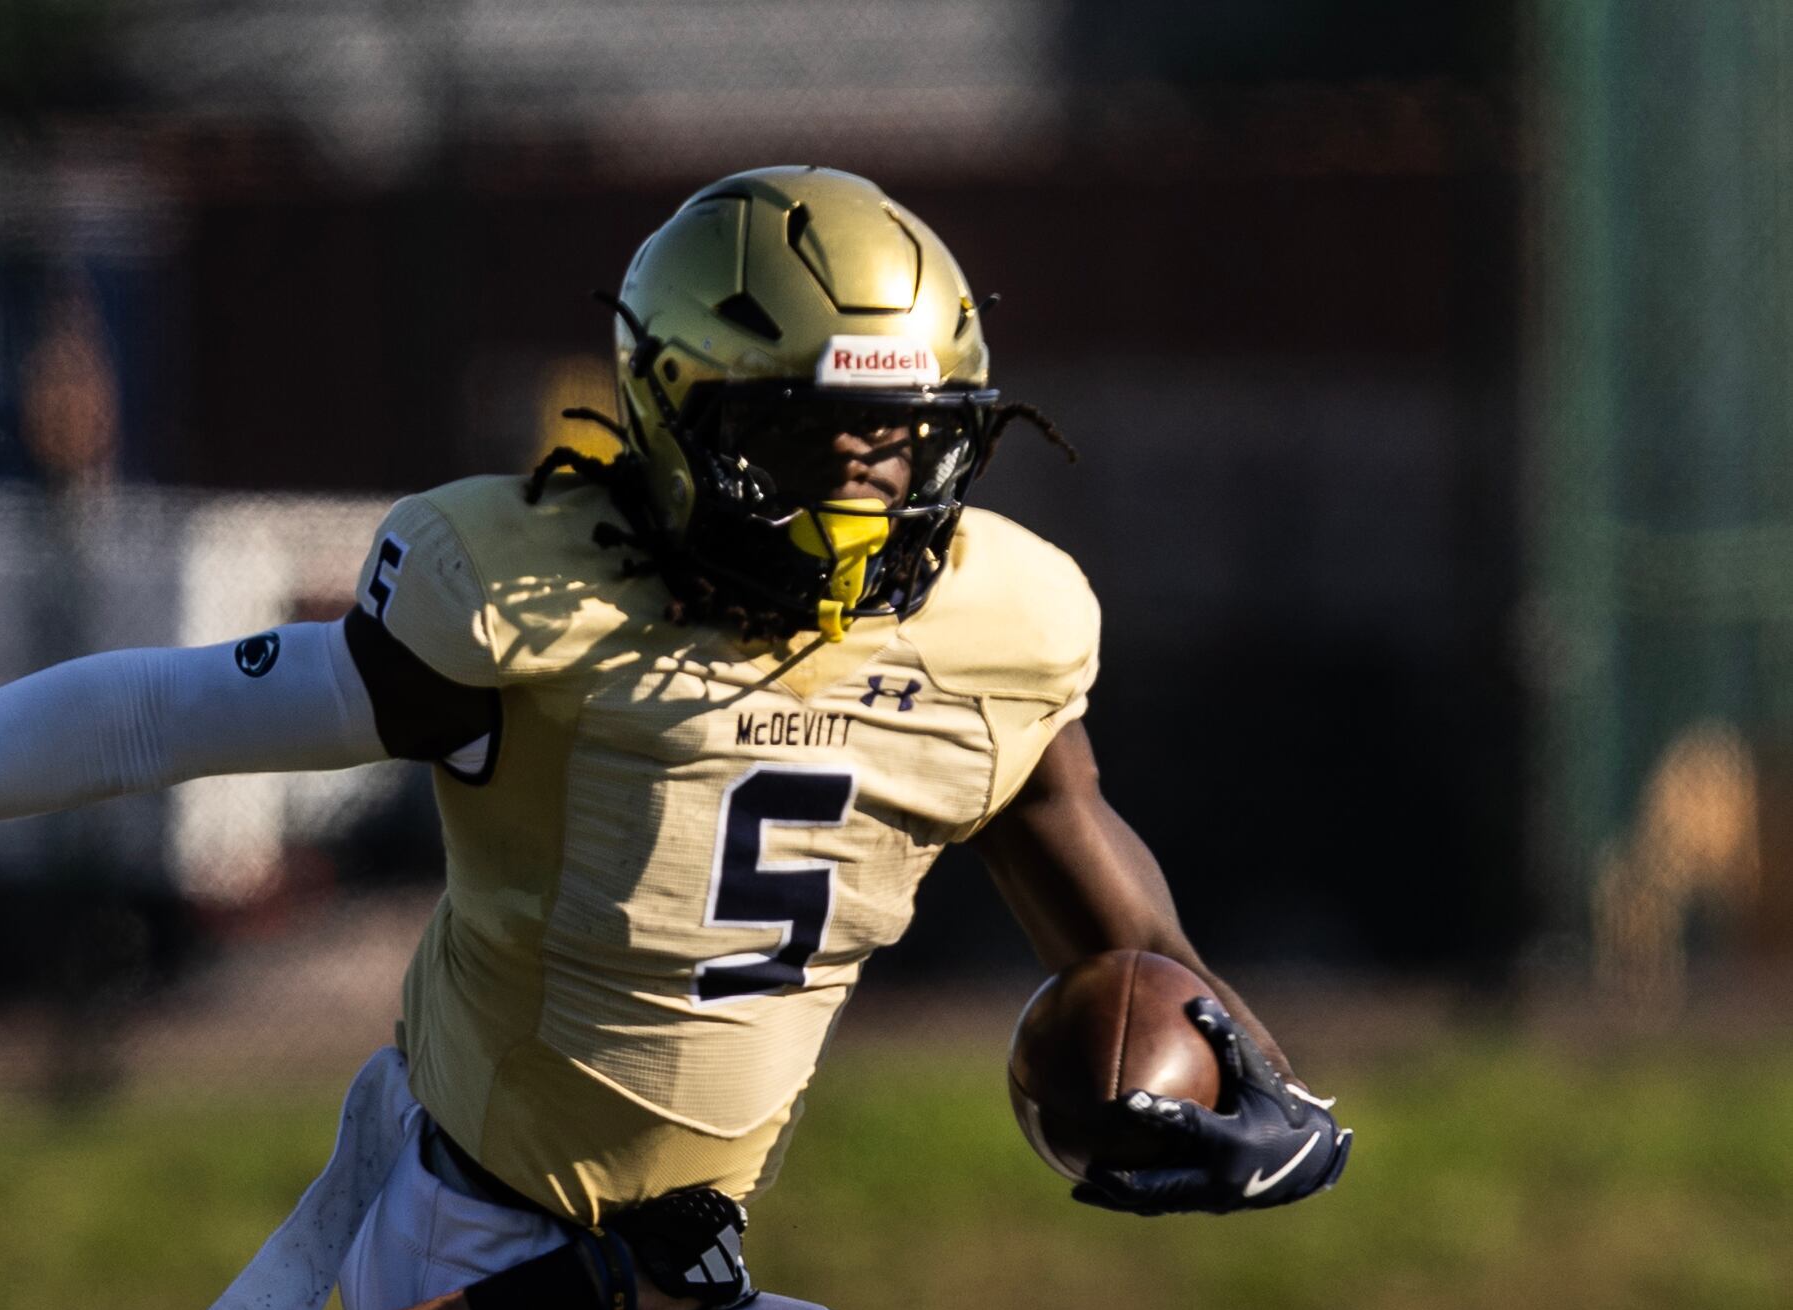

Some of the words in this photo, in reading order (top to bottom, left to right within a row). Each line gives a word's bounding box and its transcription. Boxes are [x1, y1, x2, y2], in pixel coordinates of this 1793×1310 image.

[833, 349, 928, 370] Riddell
[366, 531, 412, 622] 5
[735, 711, 854, 747] McDEVITT
[690, 761, 859, 1009] 5
